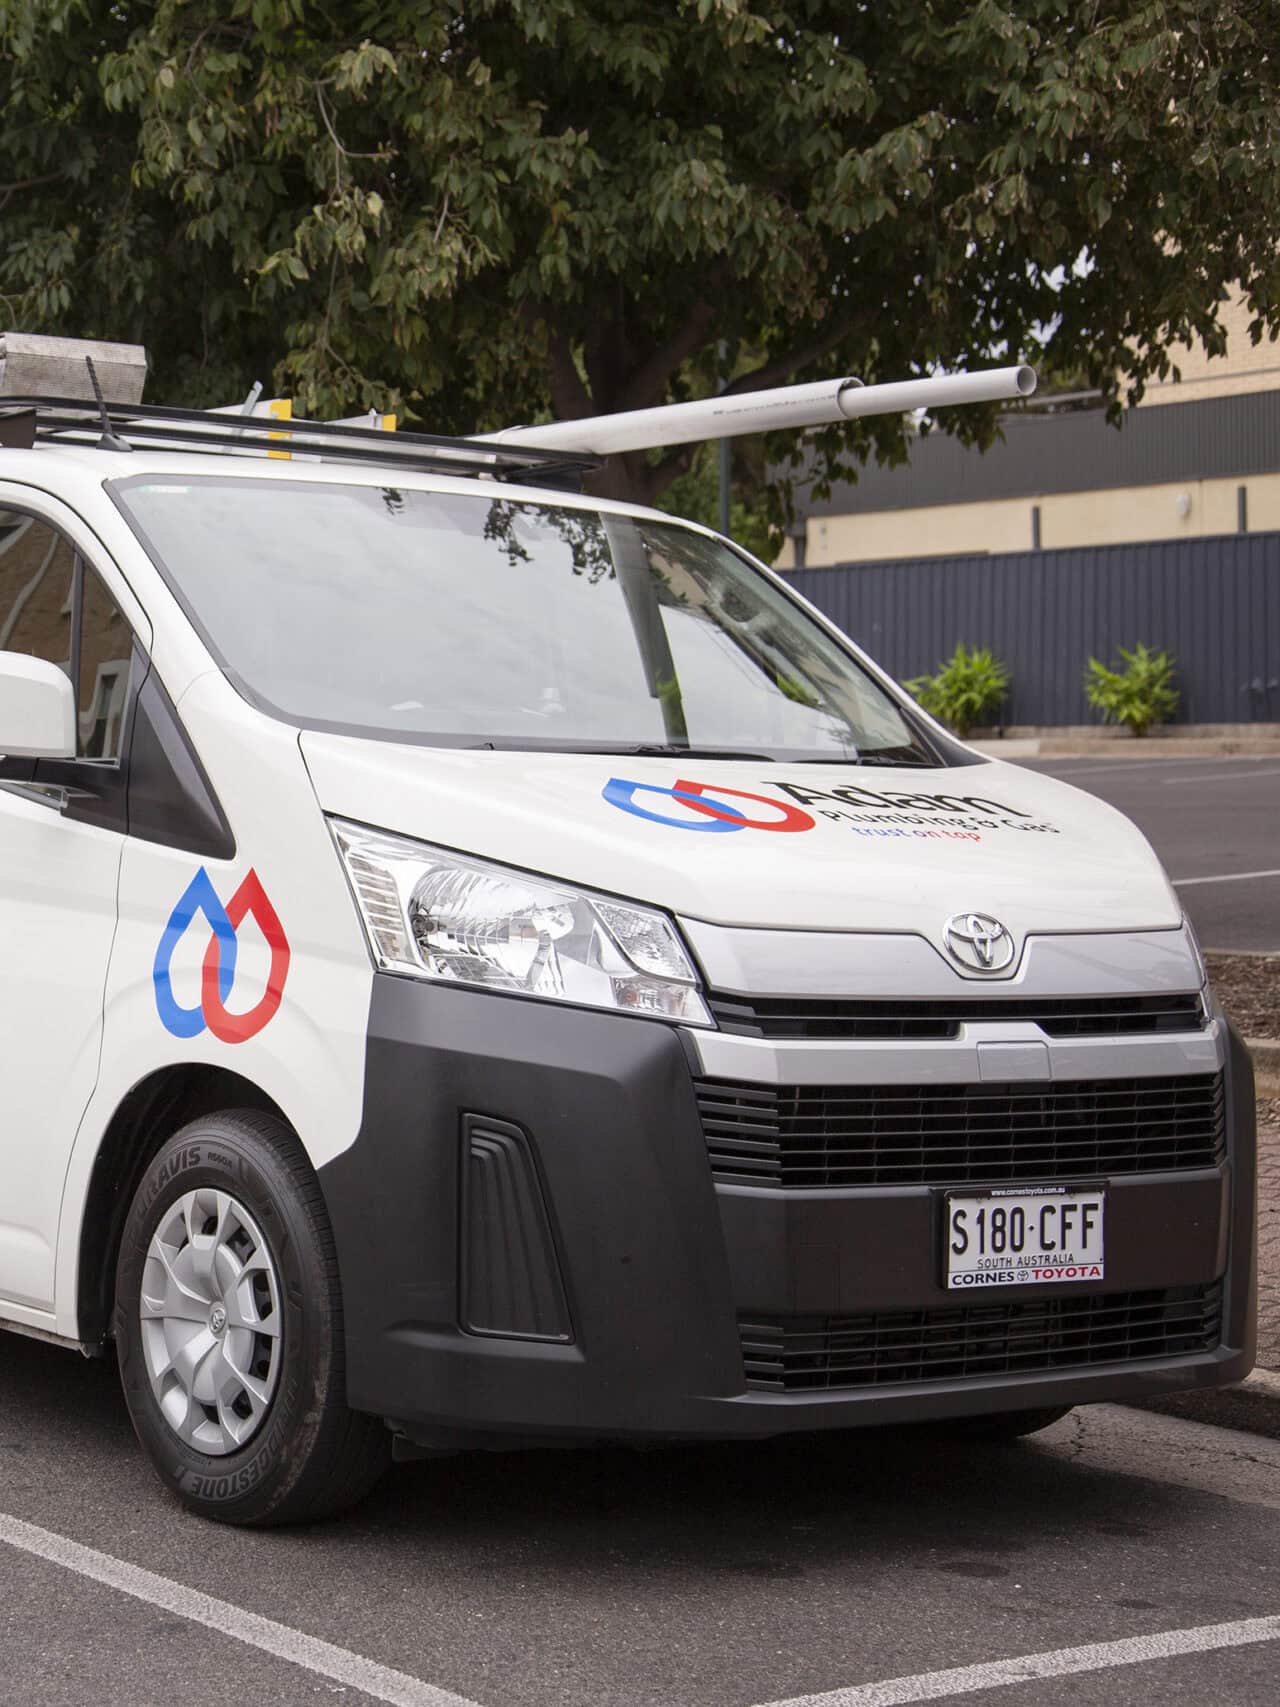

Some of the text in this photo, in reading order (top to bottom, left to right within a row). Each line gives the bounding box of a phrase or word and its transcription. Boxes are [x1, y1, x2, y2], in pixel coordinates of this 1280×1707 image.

[760, 781, 1033, 818] Adam
[817, 809, 978, 831] Plumbing
[1001, 819, 1061, 833] Gas
[851, 826, 981, 843] trust on tap
[977, 1252, 1075, 1269] SOUTH AUSTRALIA
[951, 1265, 1101, 1286] CORNES TOYOTA
